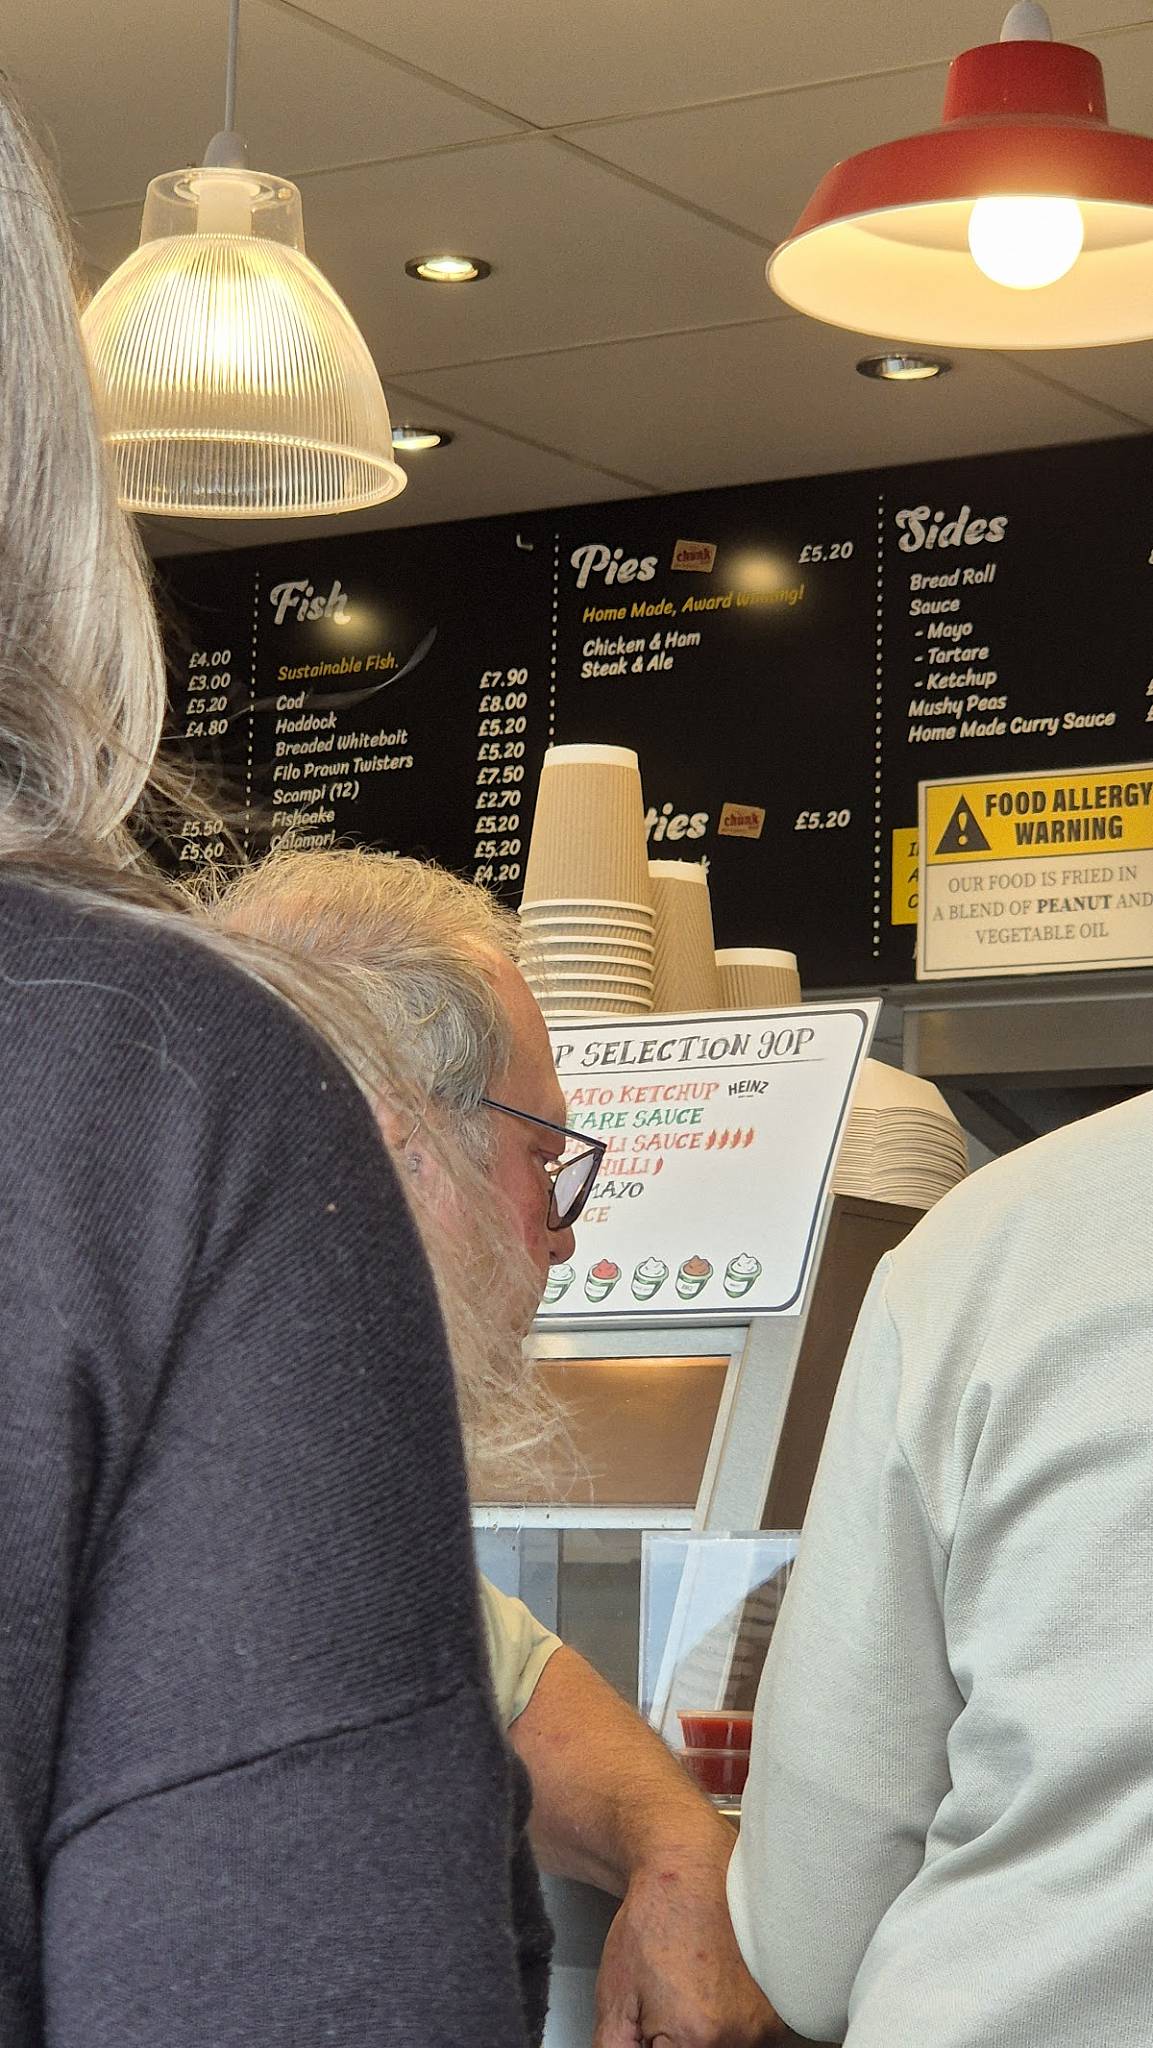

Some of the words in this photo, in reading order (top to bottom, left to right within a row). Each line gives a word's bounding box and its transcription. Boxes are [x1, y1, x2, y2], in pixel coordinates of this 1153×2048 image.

[895, 505, 1008, 553] Sides
[798, 541, 853, 564] £5.20
[570, 544, 658, 589] Pies
[910, 568, 961, 590] Bread
[962, 563, 996, 585] Roll
[270, 579, 351, 625] Fish
[582, 606, 627, 623] Home
[630, 598, 677, 617] Made,
[681, 591, 733, 613] Award
[737, 584, 805, 608] Wing!
[909, 598, 960, 616] Sauce
[927, 622, 973, 642] Mayo
[583, 635, 645, 657] Chicken
[649, 632, 661, 650] &
[665, 631, 701, 648] Ham
[928, 646, 989, 664] Tartare
[188, 650, 231, 669] £4.00
[277, 657, 361, 681] Sustainable
[365, 651, 399, 671] Fish.
[580, 656, 628, 678] Steak
[631, 655, 643, 673] &
[646, 651, 674, 671] Ale
[187, 673, 231, 691] £3.00
[479, 668, 528, 689] £7.90
[926, 668, 997, 690] Ketchup
[186, 696, 227, 715] £5.20
[276, 691, 305, 711] Cod
[478, 692, 527, 713] £8.00
[908, 696, 963, 719] Mushy
[966, 695, 1007, 711] Peas
[186, 719, 228, 737] £4.80
[275, 710, 337, 734] Haddock
[477, 716, 527, 737] £5.20
[908, 725, 956, 743] Home
[959, 717, 1006, 738] Made
[1010, 716, 1060, 736] Curry
[1062, 710, 1116, 730] Sauce
[275, 734, 335, 757] Breaded
[337, 729, 408, 750] Whitebait
[477, 741, 525, 761] £5.20
[273, 763, 300, 782] Filo
[304, 761, 350, 778] Prawn
[353, 755, 414, 773] Twisters
[476, 765, 524, 786] £7.50
[273, 784, 326, 805] Scampi
[329, 780, 360, 801] (12)
[475, 790, 521, 810] £2.70
[985, 791, 1046, 817] FOOD
[1052, 782, 1153, 811] ALLERGY
[272, 806, 335, 827] Fishcake
[475, 814, 519, 834] £5.20
[794, 808, 850, 830] £5.20
[181, 820, 223, 837] £5.50
[1015, 815, 1123, 846] WARNING
[474, 839, 521, 858] £5.20
[474, 863, 520, 882] £4.20
[948, 876, 984, 894] OUR
[988, 873, 1036, 890] FOOD
[1042, 871, 1057, 887] IS
[1062, 868, 1113, 885] FRIED
[1119, 866, 1138, 881] IN
[932, 906, 943, 922] A
[949, 902, 1005, 920] BLEND
[1009, 900, 1032, 917] OF
[1036, 895, 1112, 913] PEANUT
[1116, 892, 1153, 909] AND
[976, 925, 1075, 945] VEGETABLE
[1079, 922, 1109, 938] OIL
[581, 1034, 751, 1067] SELECTION
[758, 1027, 815, 1060] 90P
[566, 1087, 614, 1106] ATO
[618, 1082, 720, 1104] KETCHUP
[728, 1080, 769, 1096] HEINZ
[633, 1107, 704, 1129] SAUCE
[632, 1132, 704, 1151] SAUCE
